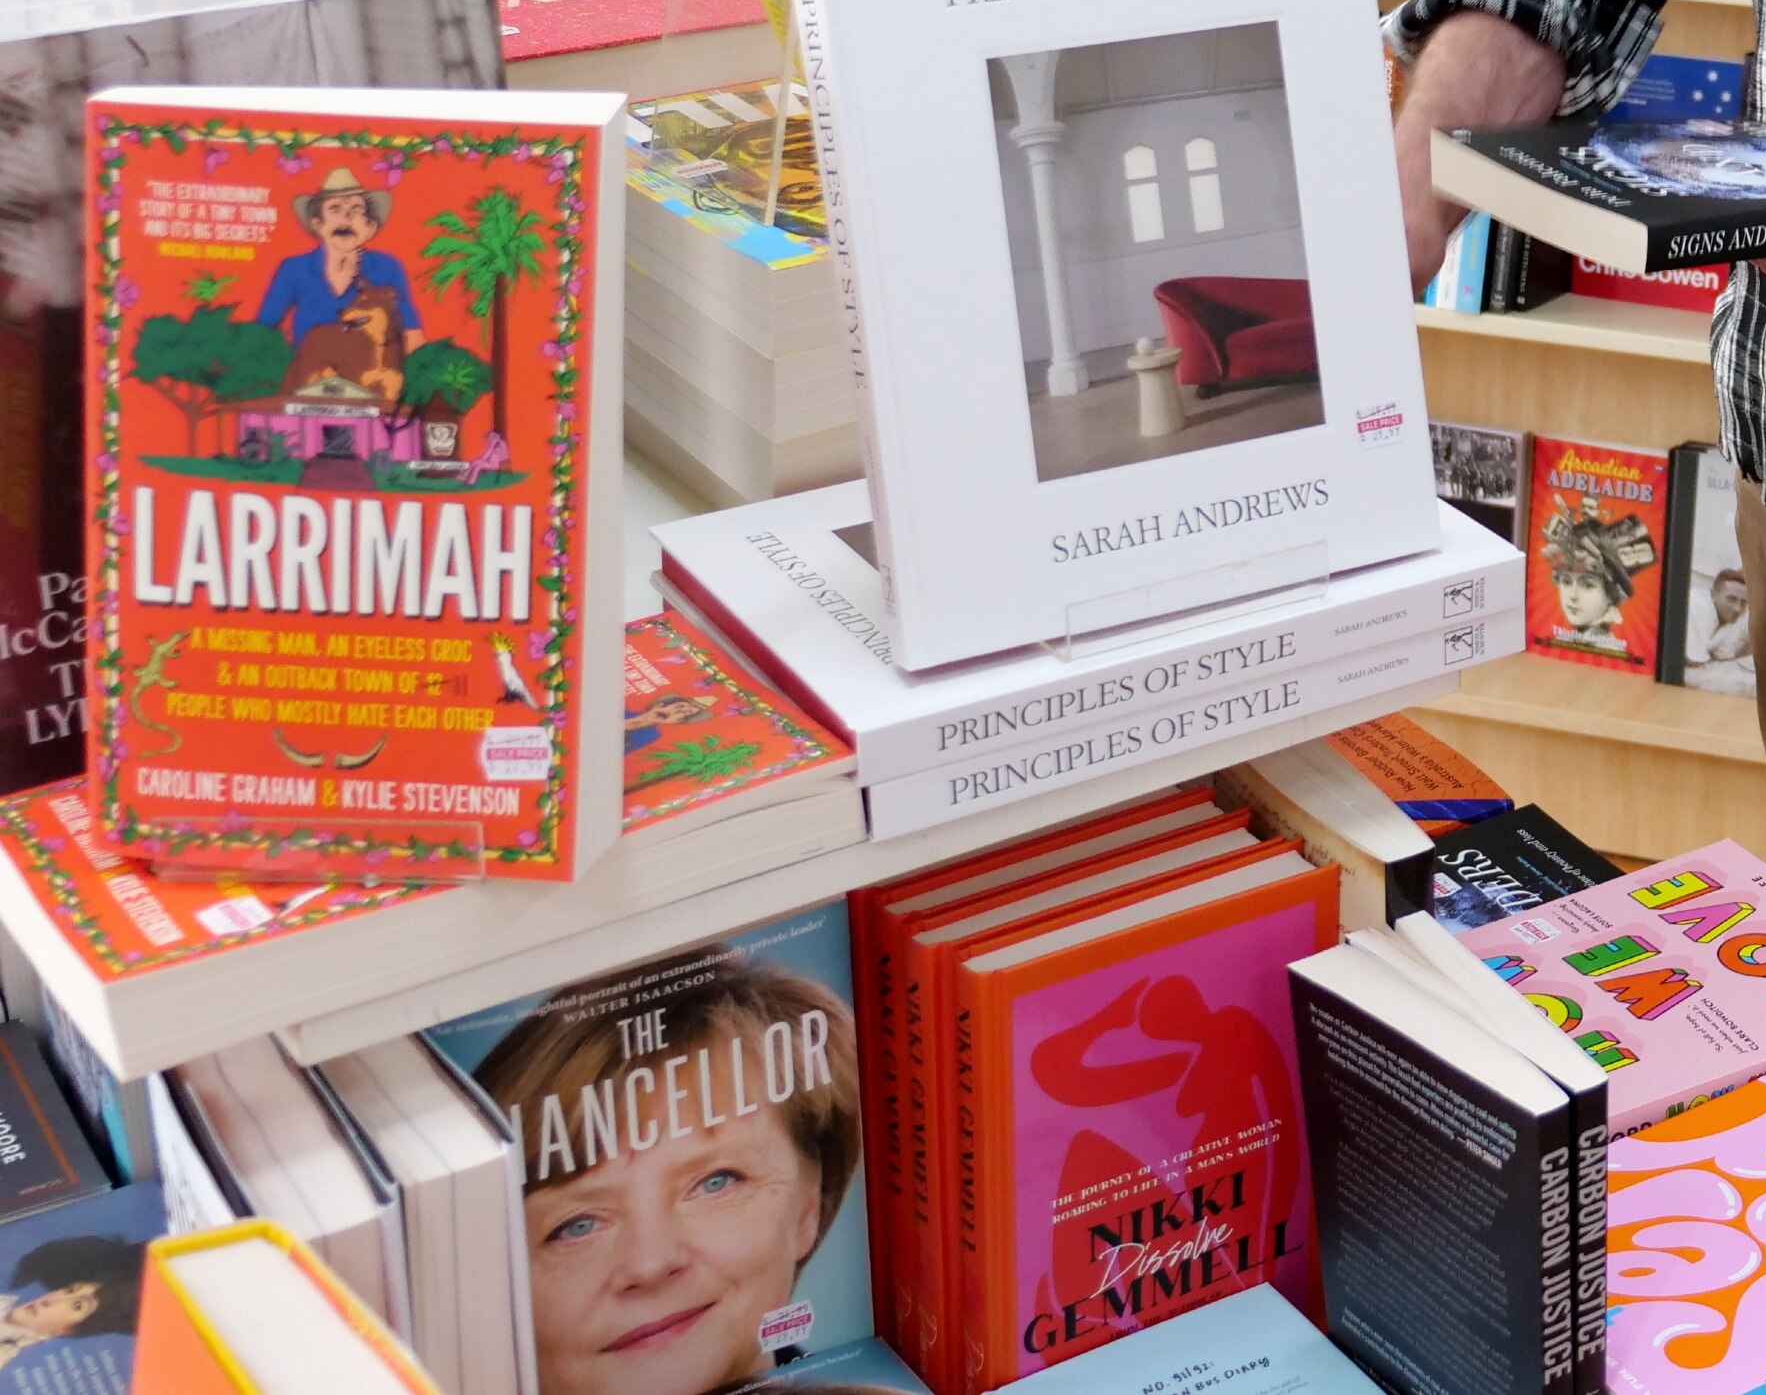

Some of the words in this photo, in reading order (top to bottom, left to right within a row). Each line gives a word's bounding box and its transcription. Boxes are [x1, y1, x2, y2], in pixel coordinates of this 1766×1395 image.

[1667, 229, 1728, 260] SIGNS
[1546, 467, 1654, 502] ADELAIDE
[1557, 449, 1642, 481] Arcadian
[132, 485, 534, 624] LARRIMAH
[1051, 515, 1164, 565] SARAH
[1172, 477, 1331, 538] ANDREWS
[207, 628, 273, 653] MISSING
[277, 632, 321, 657] MAN,
[326, 634, 350, 657] AN
[353, 635, 426, 661] EYELESS
[430, 638, 472, 663] CROC
[266, 664, 337, 692] OUTBACK
[343, 667, 394, 693] TOWN
[166, 694, 226, 719] PEOPLE
[231, 698, 271, 722] WHO
[276, 700, 342, 725] MOSTLY
[347, 703, 389, 727] HATE
[394, 706, 437, 730] EACH
[442, 707, 495, 731] OTHER
[935, 674, 1137, 753] PRINCIPLES
[1144, 659, 1192, 697] OF
[1196, 632, 1298, 682] STYLE
[136, 767, 226, 800] CAROLINE
[231, 773, 318, 807] GRAHAM
[322, 780, 338, 807] &
[342, 780, 397, 811] KYLIE
[402, 782, 520, 816] STEVENSON
[562, 1000, 630, 1025] WALTER
[634, 970, 716, 1003] ISAACSON
[579, 981, 628, 1005] portrait
[661, 945, 747, 983] extraordinarily
[749, 931, 789, 954] private
[617, 1008, 669, 1060] THE
[1080, 1172, 1132, 1199] JOURNEY
[1172, 1136, 1232, 1164] CREATIVE
[1237, 1118, 1282, 1141] WOMAN
[1196, 1150, 1234, 1170] MAN'S
[1238, 1133, 1281, 1154] WORLD
[1576, 1123, 1608, 1242] CARBON
[1088, 1170, 1246, 1263] NIKKI
[1540, 1145, 1571, 1268] CARBON
[1022, 1220, 1306, 1355] GEMMELL
[1089, 1216, 1233, 1300] Dissolve
[1541, 1265, 1573, 1386] JUSTICE
[1576, 1241, 1608, 1363] JUSTICE
